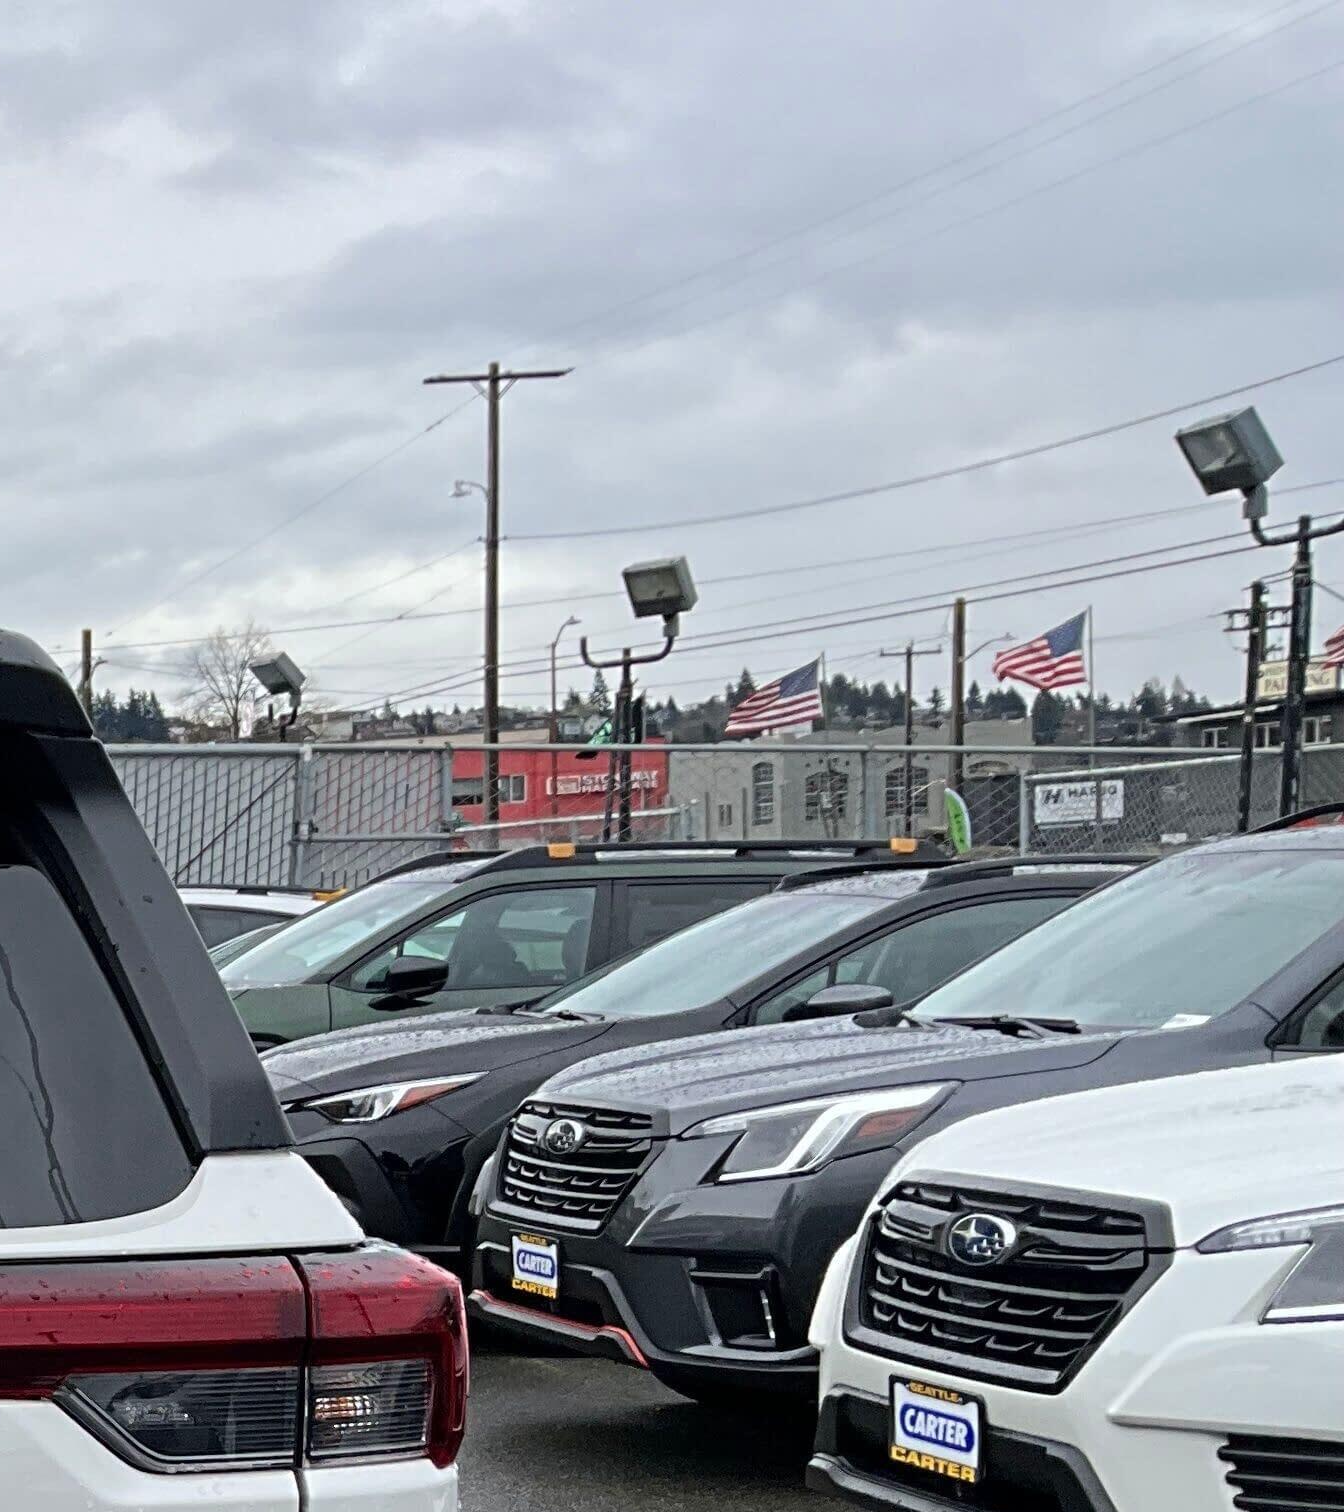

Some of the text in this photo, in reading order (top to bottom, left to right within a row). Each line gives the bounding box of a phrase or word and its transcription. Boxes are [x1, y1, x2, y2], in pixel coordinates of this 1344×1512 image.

[518, 1252, 553, 1276] CARTER
[512, 1279, 557, 1299] CARTER
[909, 1381, 960, 1403] SEATTLE
[904, 1407, 969, 1449] CARTER
[891, 1445, 977, 1484] CARTER
